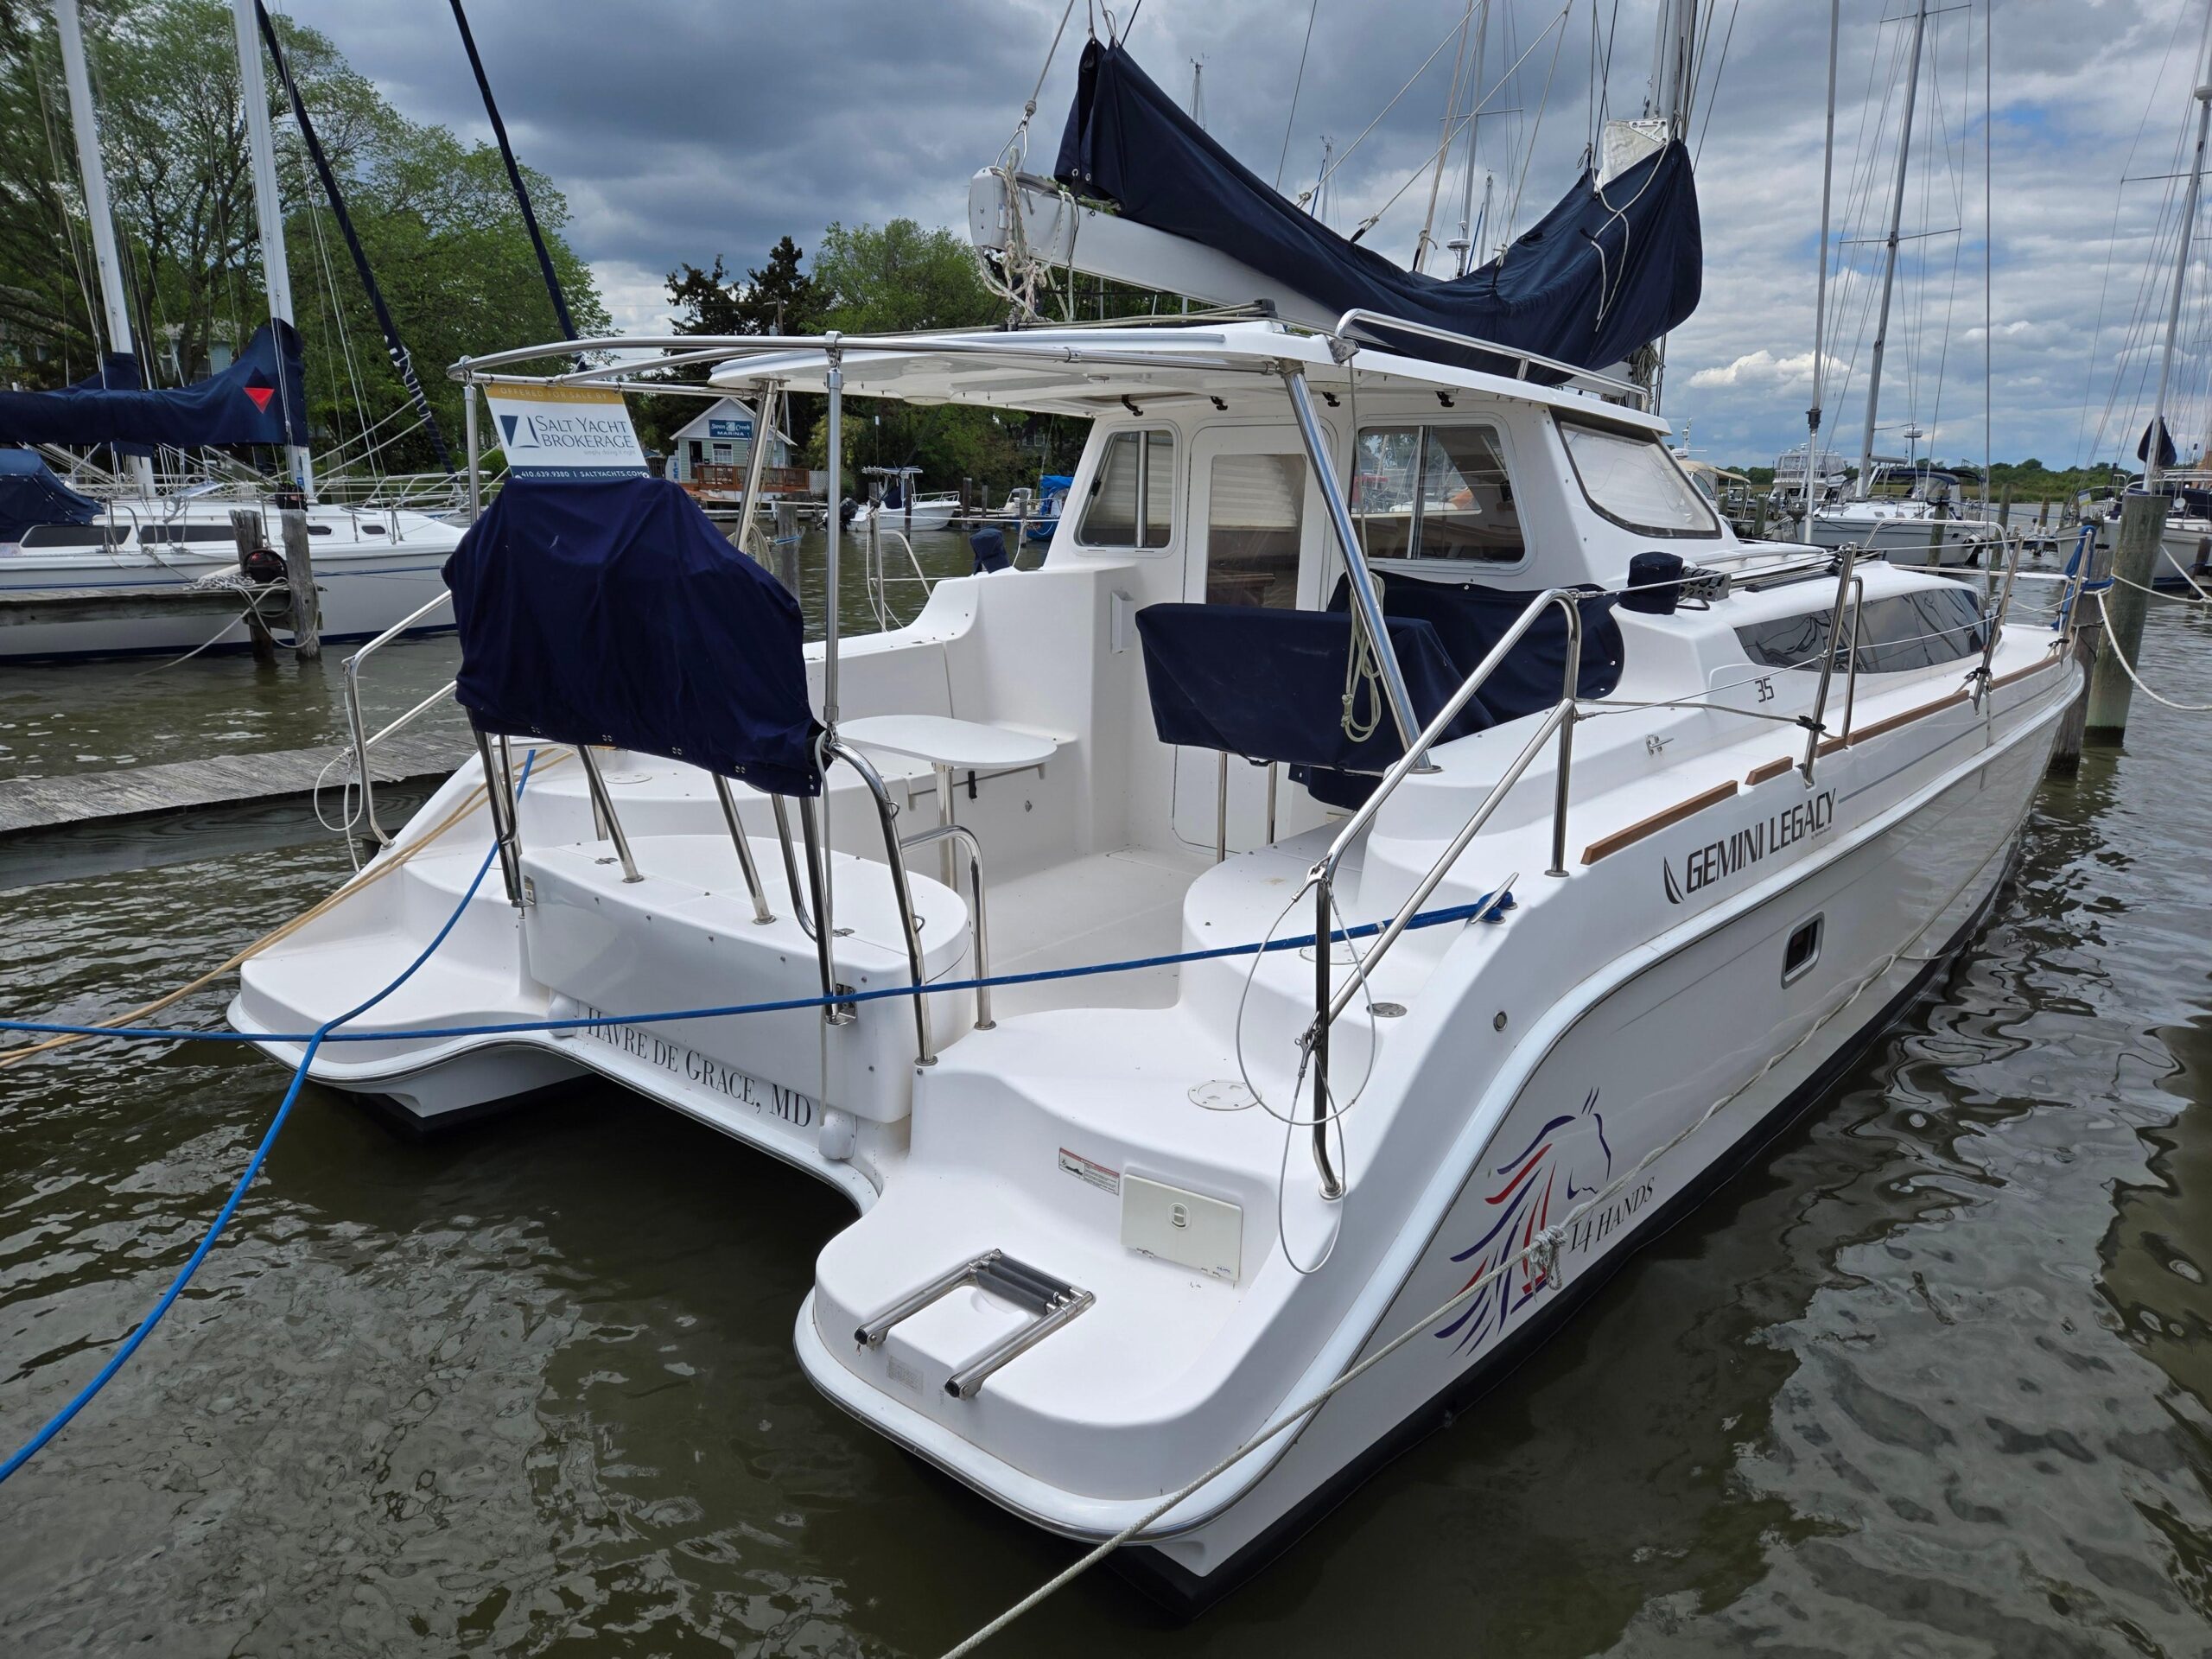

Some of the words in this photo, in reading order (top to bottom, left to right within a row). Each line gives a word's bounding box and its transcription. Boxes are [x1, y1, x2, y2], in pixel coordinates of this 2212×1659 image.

[500, 387, 543, 397] OFFERED
[547, 390, 567, 398] FOR
[575, 416, 626, 434] YACHT
[541, 434, 634, 448] BROKERAGE
[1754, 677, 1775, 702] 35
[1686, 822, 1764, 894] GEMINI
[1769, 787, 1836, 855] LEGACY
[652, 1038, 678, 1072] DE
[685, 1050, 762, 1115] GRACE,
[769, 1083, 811, 1128] MD
[1568, 1208, 1594, 1254] 14
[1596, 1175, 1655, 1243] HANDS
